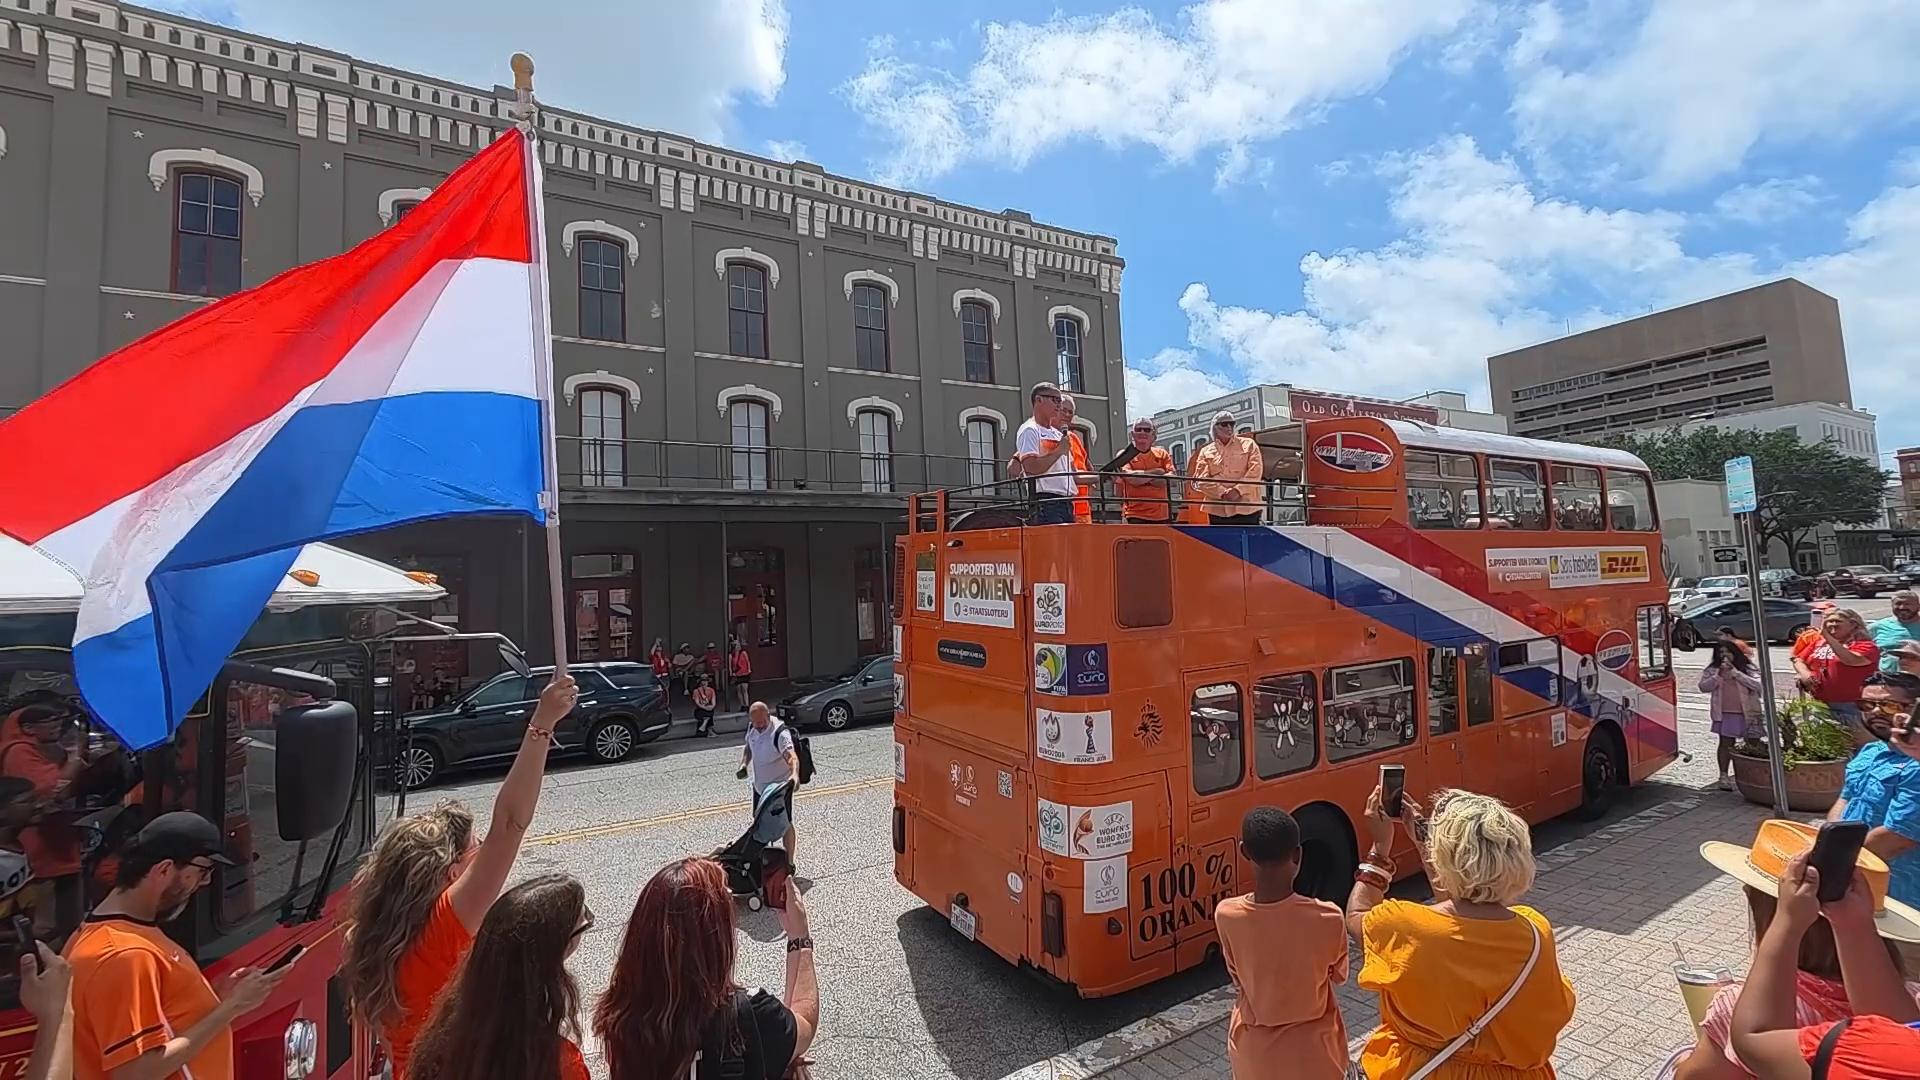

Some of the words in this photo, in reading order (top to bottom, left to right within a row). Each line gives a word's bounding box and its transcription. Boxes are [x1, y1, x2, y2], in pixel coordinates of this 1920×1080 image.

[1302, 400, 1325, 414] OLD
[950, 562, 994, 576] SUPPORTER
[996, 563, 1014, 576] VAN
[1606, 556, 1641, 573] DHL
[950, 577, 1014, 602] DROMEN
[969, 606, 1009, 618] STAATSLOTERIJ
[1099, 823, 1130, 837] WOMEN'S
[1096, 834, 1115, 844] EURO
[1116, 831, 1132, 842] 2017
[1010, 874, 1021, 890] NL
[1141, 863, 1196, 912] 100
[1205, 850, 1233, 889] %
